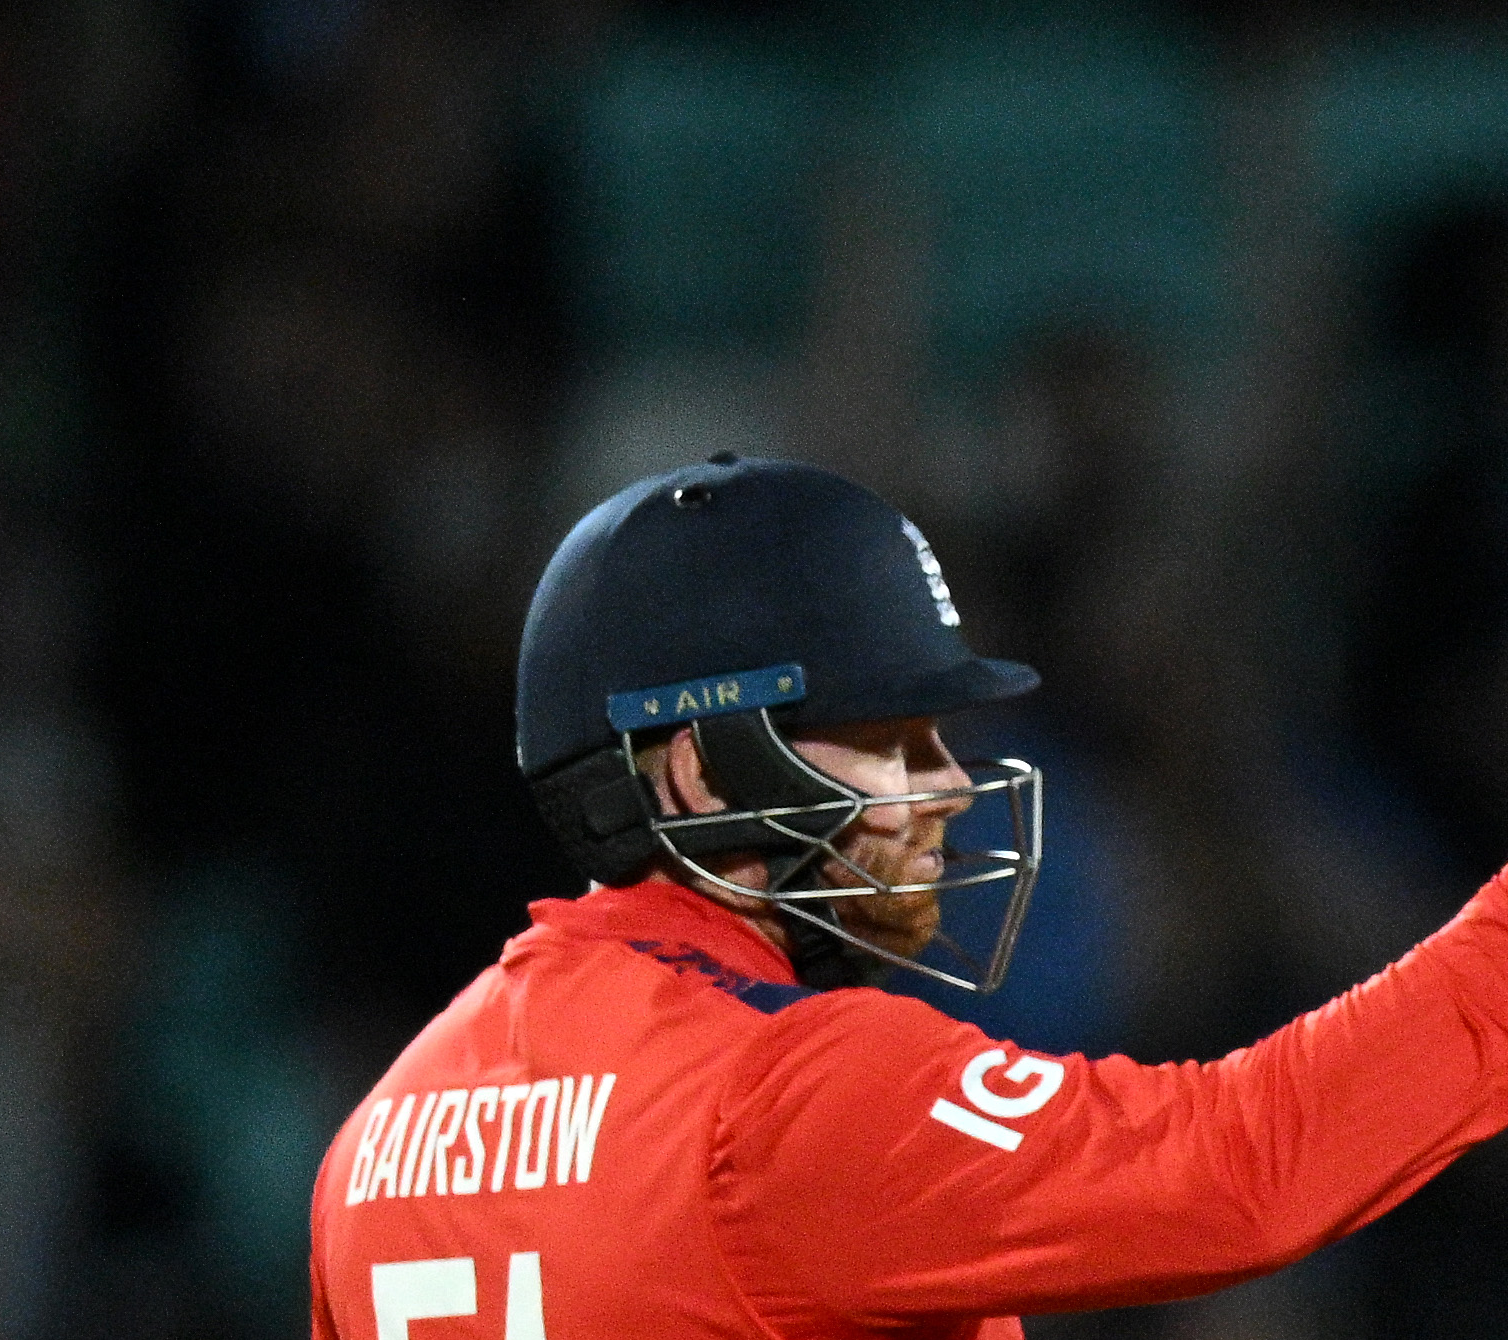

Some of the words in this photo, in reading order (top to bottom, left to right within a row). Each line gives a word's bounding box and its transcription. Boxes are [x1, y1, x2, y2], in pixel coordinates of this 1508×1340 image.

[675, 680, 740, 715] AIR
[345, 1073, 617, 1207] BAIRSTOW
[929, 1047, 1066, 1153] IG
